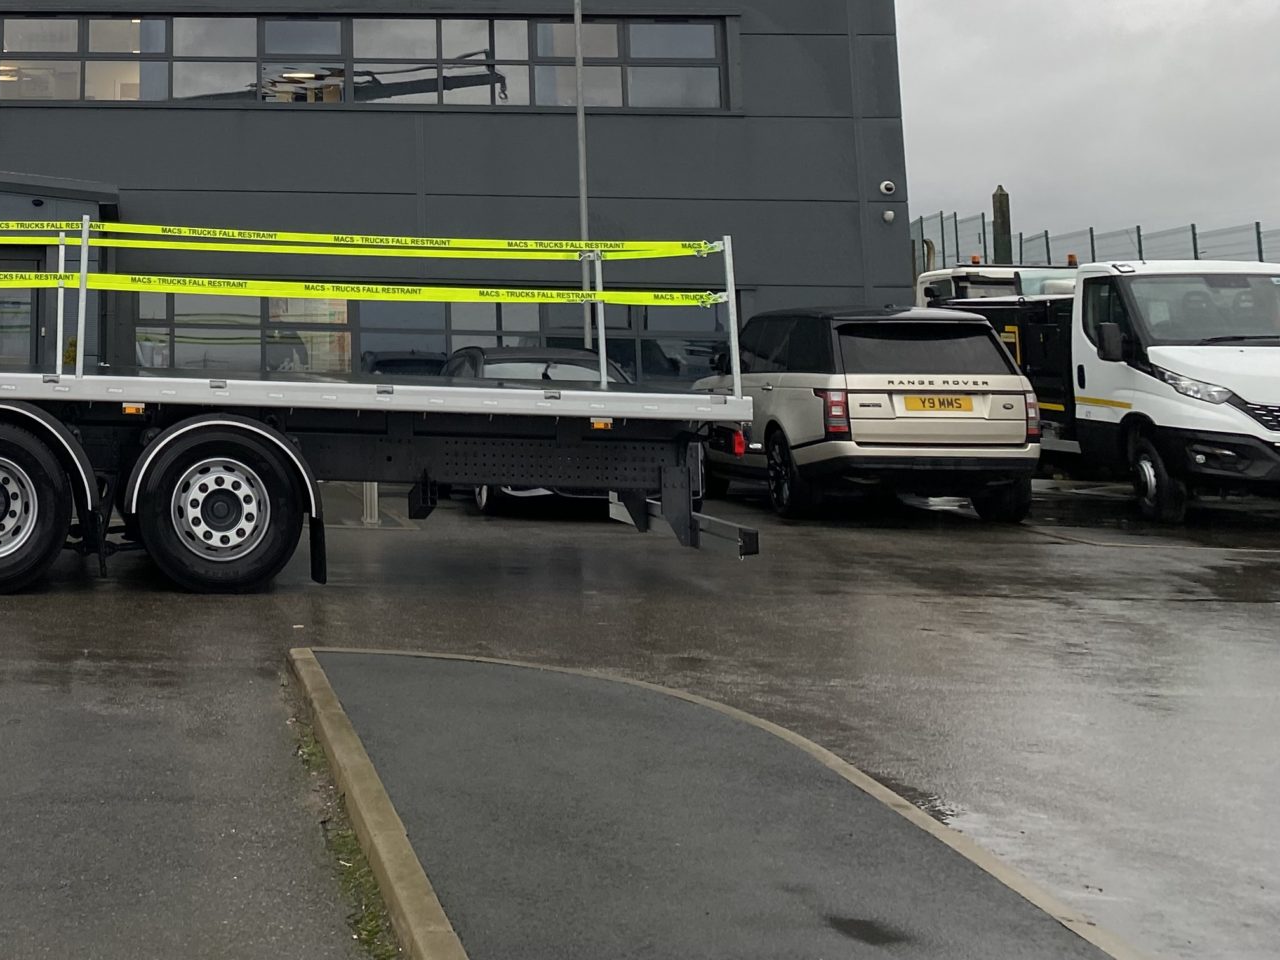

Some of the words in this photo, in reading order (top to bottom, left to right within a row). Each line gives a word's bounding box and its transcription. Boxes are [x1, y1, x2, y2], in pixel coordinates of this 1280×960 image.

[65, 222, 105, 230] RESTAINT
[161, 227, 182, 235] MACS
[188, 228, 218, 237] TRUCKS
[218, 229, 236, 238] FALL
[237, 231, 278, 240] RESTRAINT
[333, 235, 355, 243] MACS
[361, 236, 390, 245] TRUCKS
[391, 237, 409, 246] FALL
[410, 239, 451, 247] RESTRAINT
[534, 241, 564, 249] TRUCKS
[584, 242, 625, 250] RESTRAINT
[681, 242, 703, 250] MACS
[15, 273, 33, 281] FALL
[34, 273, 75, 281] RESTRAINT
[130, 276, 153, 284] MACS
[157, 277, 187, 286] TRUCKS
[188, 278, 206, 287] FALL
[207, 279, 248, 288] RESTRAINT
[304, 284, 326, 292] MACS
[331, 285, 361, 294] TRUCKS
[362, 286, 380, 294] FALL
[381, 287, 422, 295] RESTRAINT
[478, 290, 501, 298] MACS
[505, 290, 536, 299] TRUCKS
[536, 291, 555, 299] FALL
[556, 292, 598, 300] RESTRAINT
[653, 293, 676, 301] MACS
[919, 397, 936, 409] Y9
[938, 397, 962, 409] MMS
